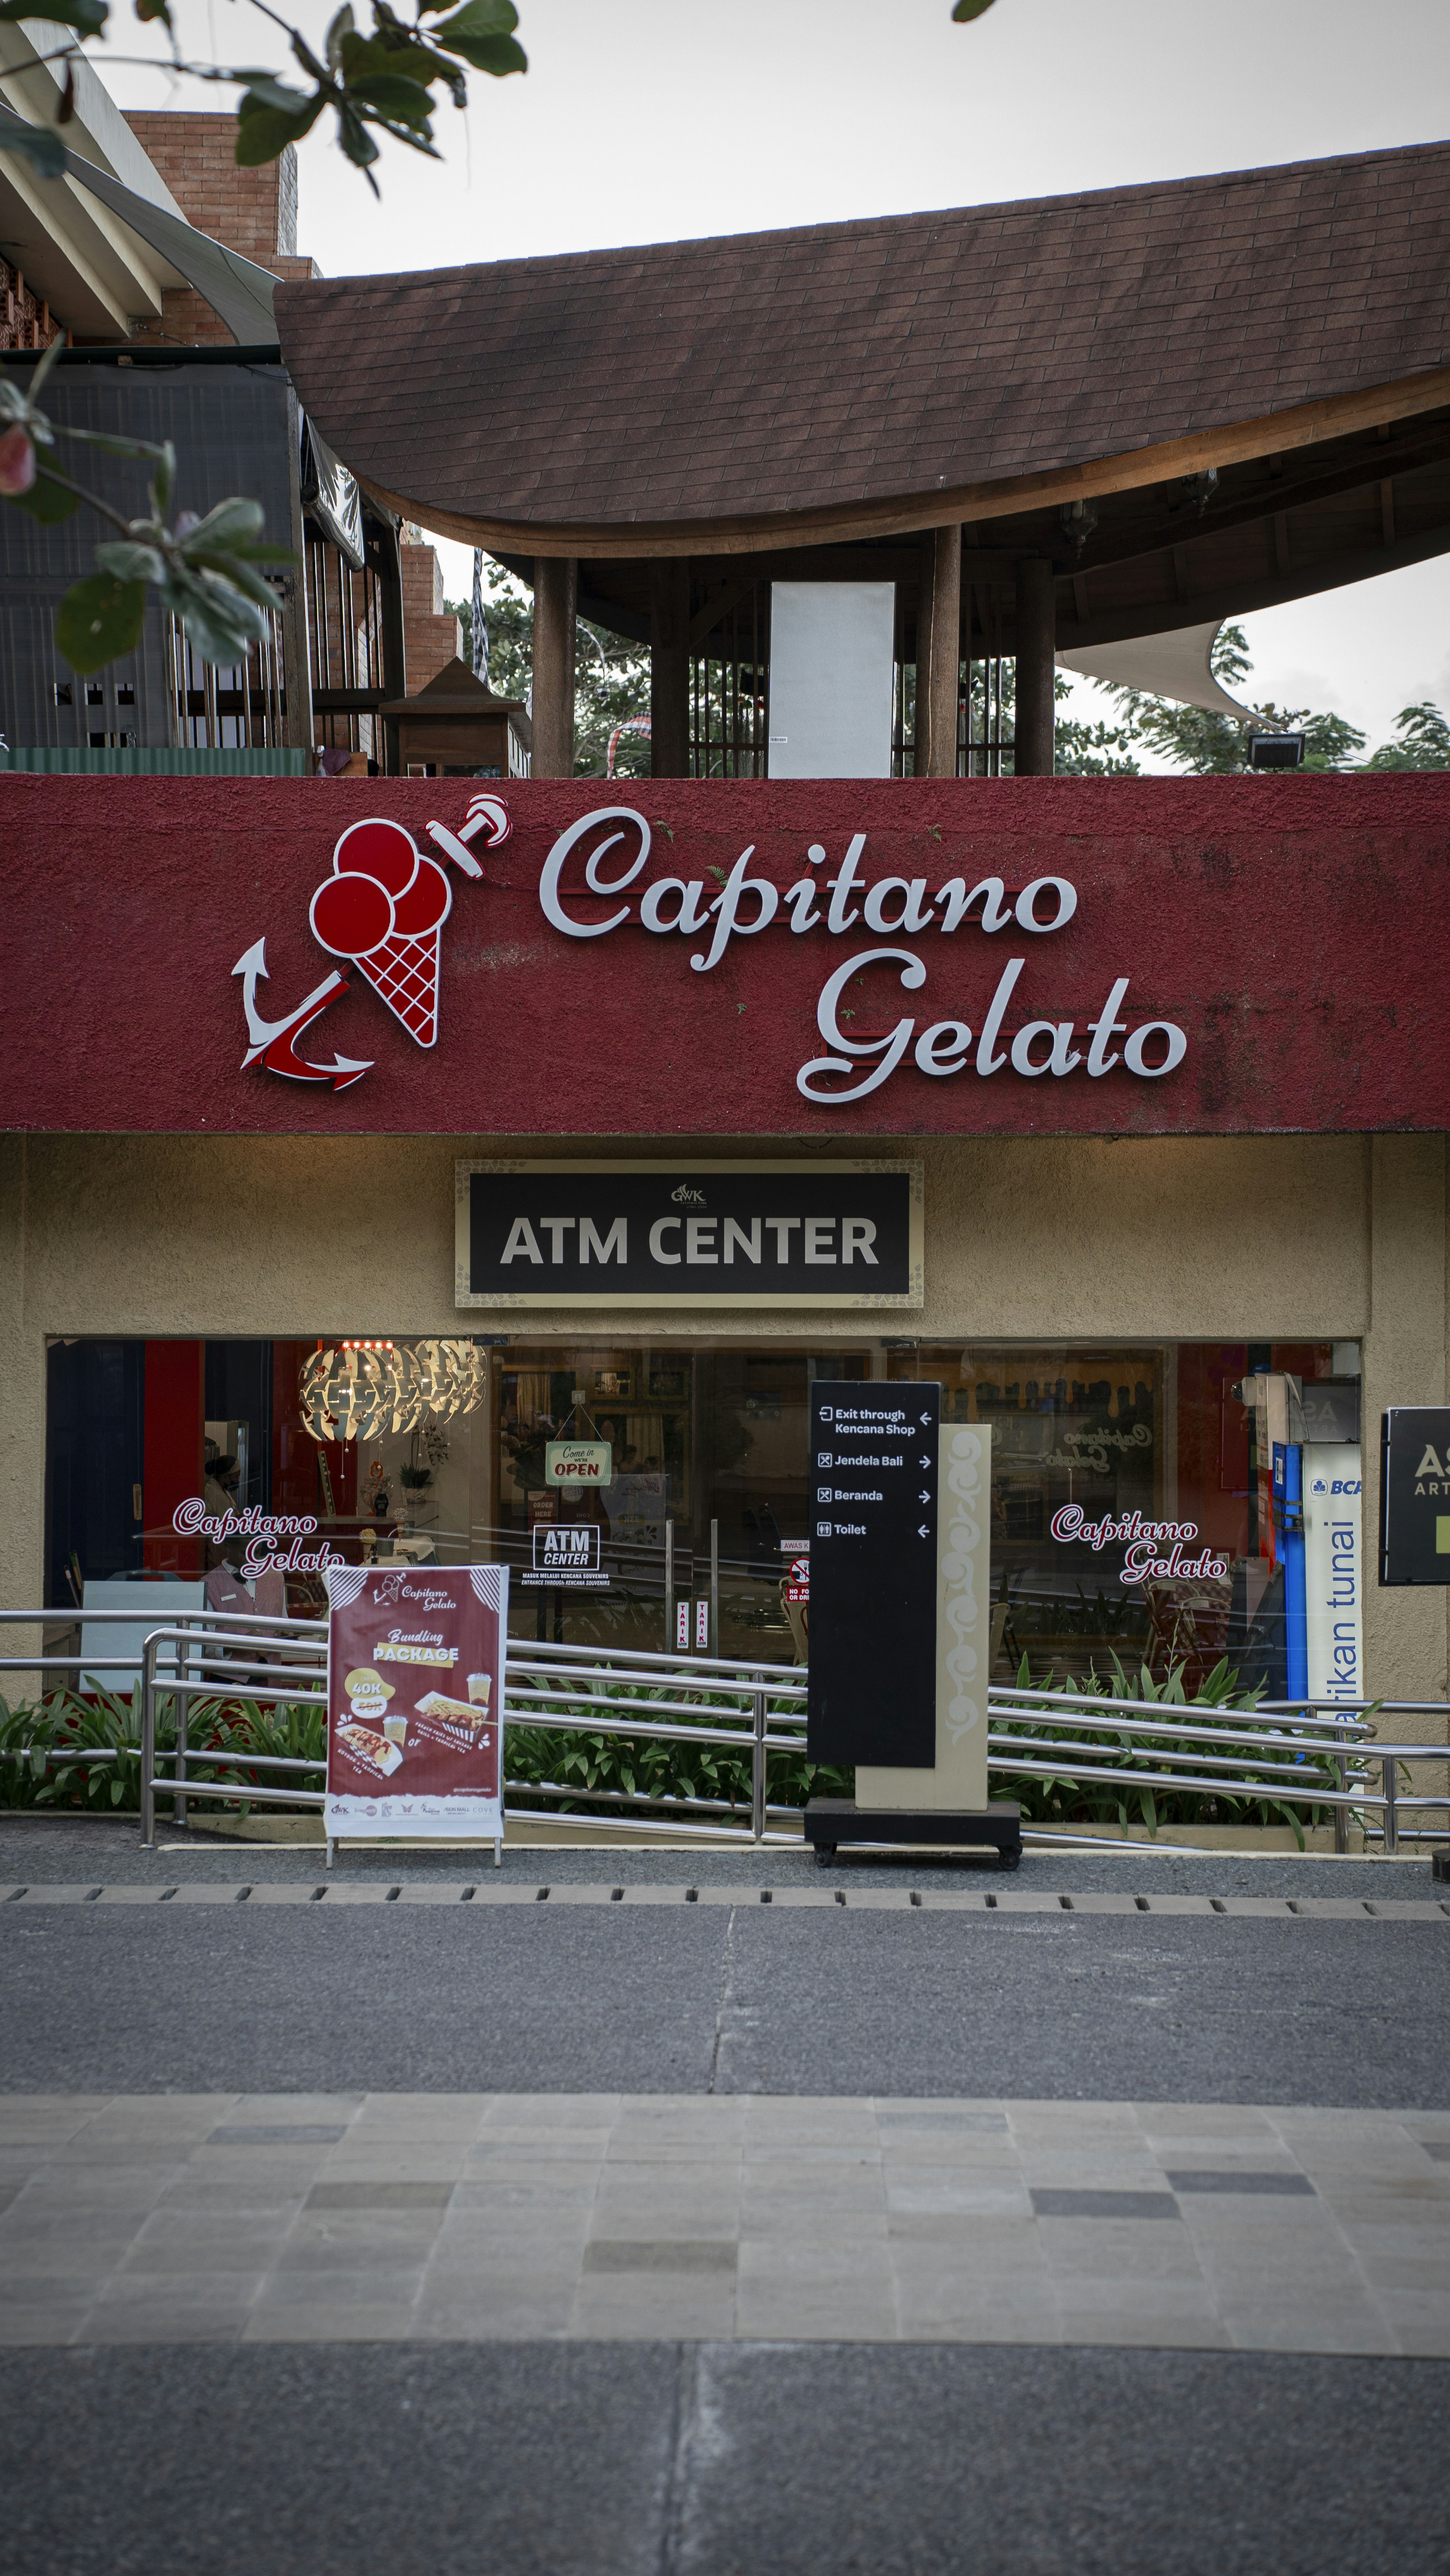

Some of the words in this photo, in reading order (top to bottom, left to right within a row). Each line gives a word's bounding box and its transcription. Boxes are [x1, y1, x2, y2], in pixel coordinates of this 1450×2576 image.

[539, 806, 1077, 972] Capitano
[796, 947, 1187, 1103] Gelato
[671, 1184, 706, 1201] GWK
[500, 1217, 628, 1264] ATM
[649, 1217, 879, 1265] CENTER
[836, 1409, 857, 1419] Exit
[859, 1409, 905, 1422] through
[835, 1424, 884, 1434] Kencana
[886, 1424, 915, 1437] Shop
[563, 1446, 585, 1458] Come
[835, 1456, 879, 1465] Jendela
[882, 1456, 903, 1466] Bali
[555, 1463, 599, 1476] OPEN
[835, 1490, 882, 1500] Beranda
[173, 1497, 318, 1544] Capitano
[1051, 1504, 1198, 1551] Capitano
[834, 1524, 866, 1534] Toilet
[544, 1531, 589, 1551] ATM
[240, 1535, 345, 1579] Gelato
[544, 1553, 588, 1565] CENTER
[1120, 1540, 1227, 1584] Gelato
[1324, 1522, 1355, 1608] tunai
[402, 1586, 448, 1600] Capitano
[423, 1597, 456, 1611] Gelato
[388, 1629, 443, 1646] Bundling
[373, 1647, 459, 1661] PACKAGE
[352, 1683, 381, 1694] 40K
[408, 1738, 421, 1746] or
[415, 1721, 433, 1732] FRENCH
[433, 1730, 445, 1738] FRIES
[453, 1738, 473, 1750] SAUSAGE
[417, 1729, 430, 1737] GRILL
[435, 1737, 456, 1749] TROPICAL
[337, 1748, 357, 1762] HOTDOG
[362, 1763, 384, 1780] TROPICAL
[352, 1765, 362, 1774] TEA
